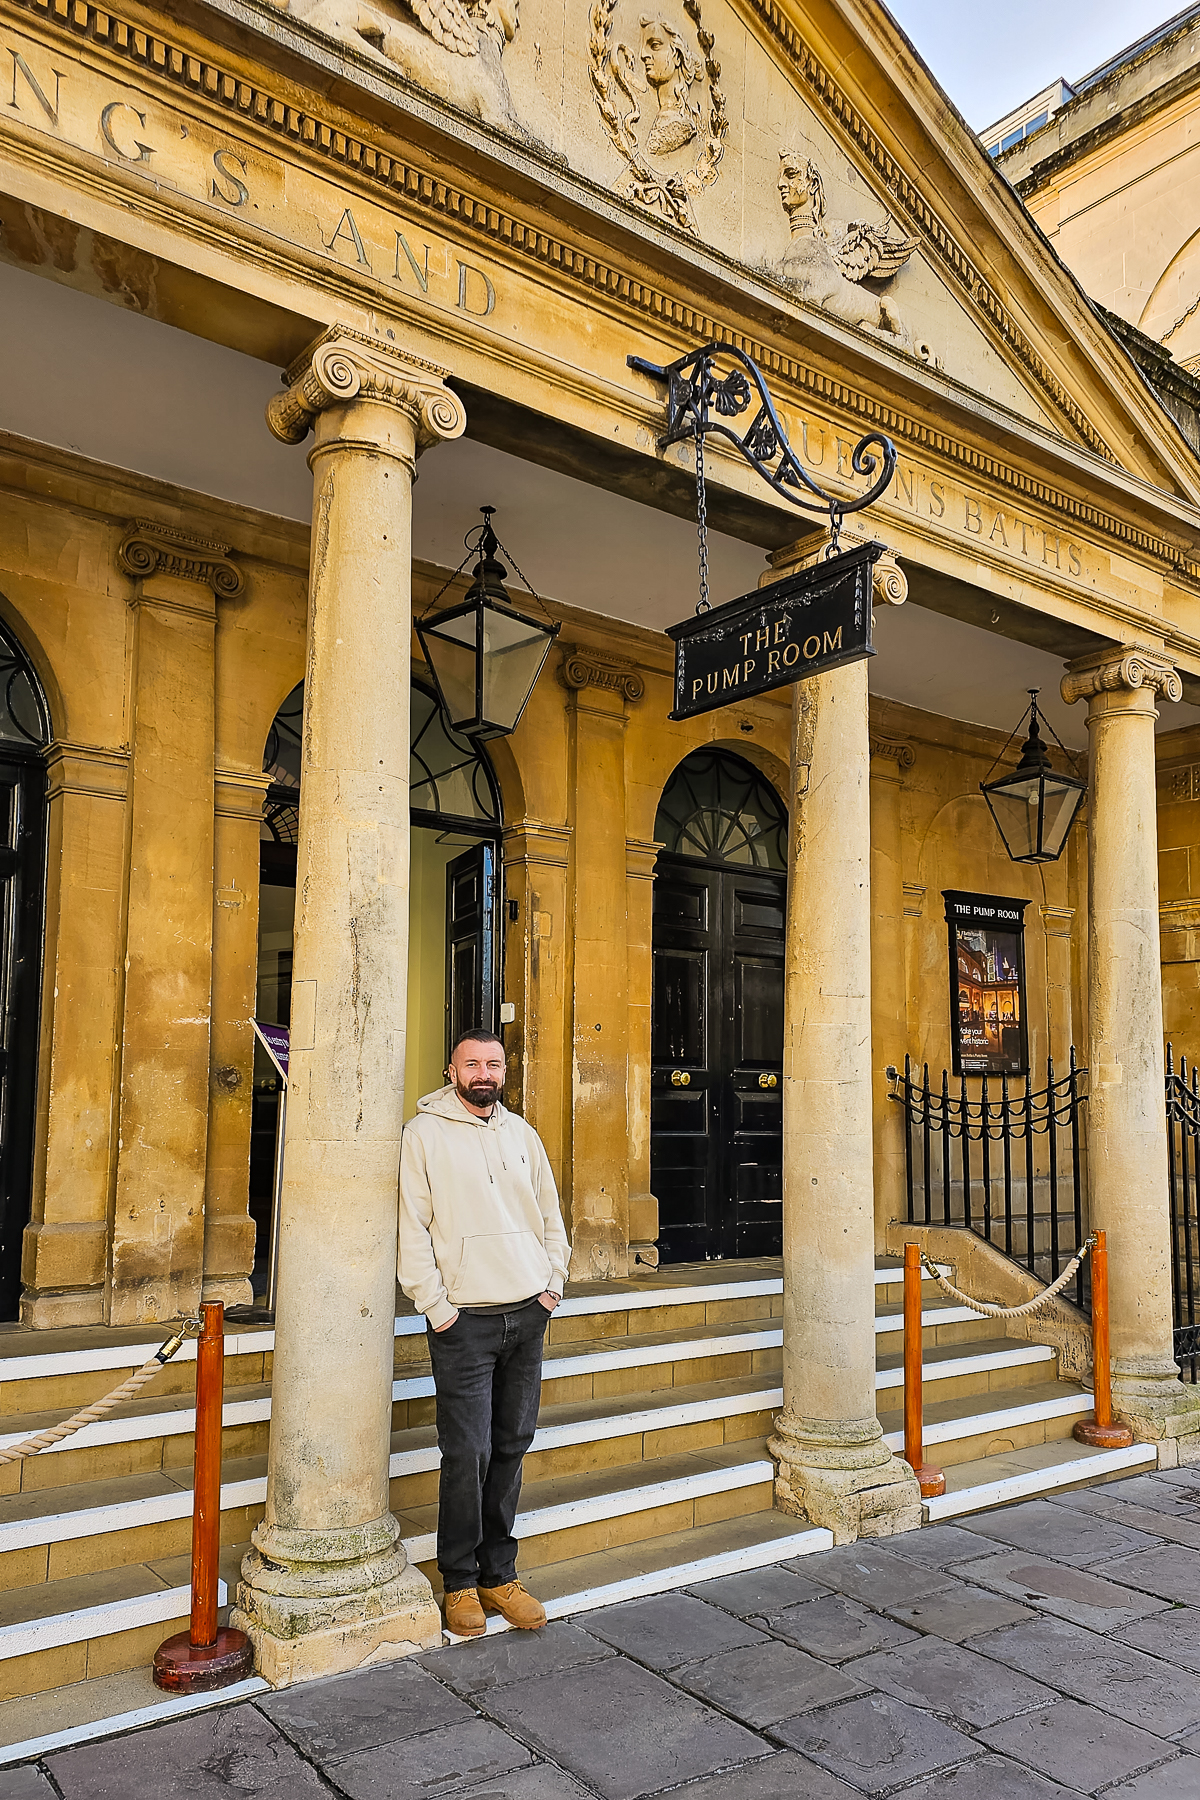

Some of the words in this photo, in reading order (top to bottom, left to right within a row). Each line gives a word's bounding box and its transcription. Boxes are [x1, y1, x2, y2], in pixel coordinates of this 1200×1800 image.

[324, 208, 496, 316] AND
[963, 494, 1082, 577] BATHS
[739, 619, 786, 656] THE
[692, 659, 756, 700] PUMP
[767, 625, 843, 674] ROOM
[954, 904, 971, 914] THE
[973, 906, 996, 917] PUMP
[997, 909, 1020, 920] ROOM
[971, 1037, 989, 1045] historic
[972, 1029, 983, 1037] your
